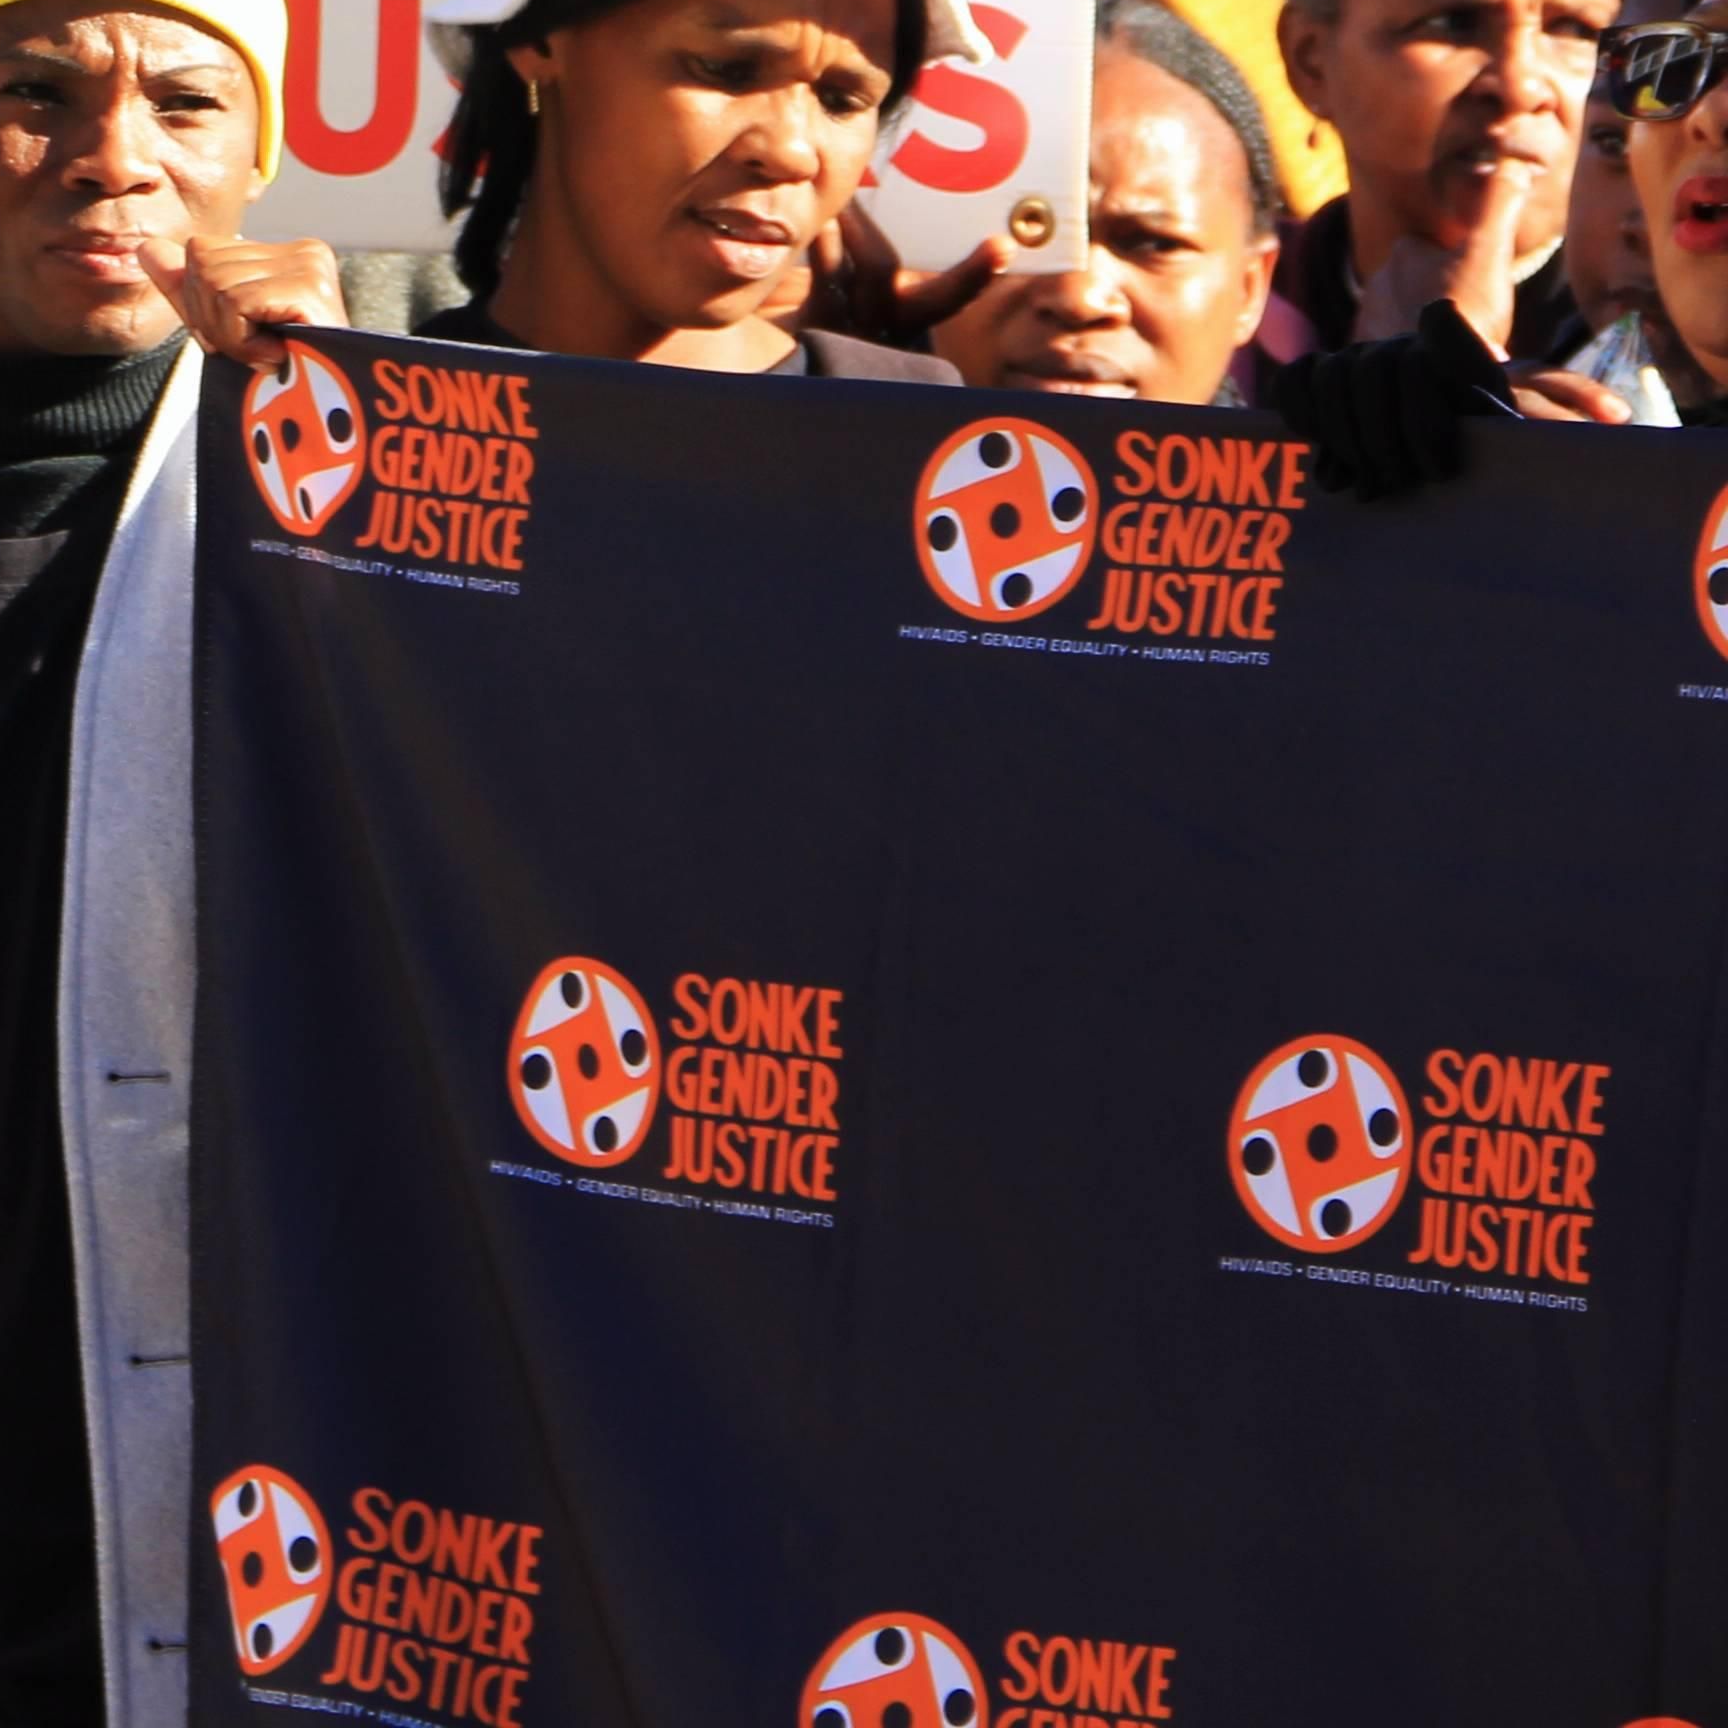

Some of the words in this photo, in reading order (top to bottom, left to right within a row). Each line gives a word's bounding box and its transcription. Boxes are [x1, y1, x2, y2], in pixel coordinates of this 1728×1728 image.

[373, 359, 539, 439] SONKE
[370, 425, 535, 504] GENDER
[1113, 430, 1311, 509] SONKE
[355, 491, 529, 571] JUSTICE
[1101, 501, 1292, 571] GENDER
[406, 568, 464, 589] HUMAN
[467, 576, 521, 596] RIGHTS
[1086, 569, 1284, 641] JUSTICE
[899, 625, 968, 645] HIV/AIDS
[980, 631, 1047, 651] GENDER
[1049, 638, 1128, 659] EQUALITY
[1141, 646, 1206, 664] HUMAN
[1209, 649, 1271, 666] RIGHTS
[671, 972, 843, 1059] SONKE
[665, 1046, 840, 1131] GENDER
[1422, 1048, 1612, 1136] SONKE
[489, 1160, 563, 1187] HIV/AIDS
[575, 1178, 639, 1200] GENDER
[640, 1186, 702, 1210] EQUALITY
[712, 1199, 771, 1221] HUMAN
[774, 1207, 834, 1228] RIGHTS
[663, 1115, 839, 1201] JUSTICE
[1417, 1124, 1596, 1210] GENDER
[1408, 1197, 1594, 1285] JUSTICE
[1219, 1257, 1293, 1278] HIV/AIDS
[1307, 1265, 1371, 1286] GENDER
[1374, 1272, 1452, 1296] EQUALITY
[1464, 1285, 1525, 1305] HUMAN
[1528, 1292, 1589, 1313] RIGHTS
[346, 1486, 543, 1595] SONKE
[337, 1557, 533, 1664] GENDER
[321, 1624, 530, 1728] JUSTICE
[1000, 1630, 1177, 1719] SONKE
